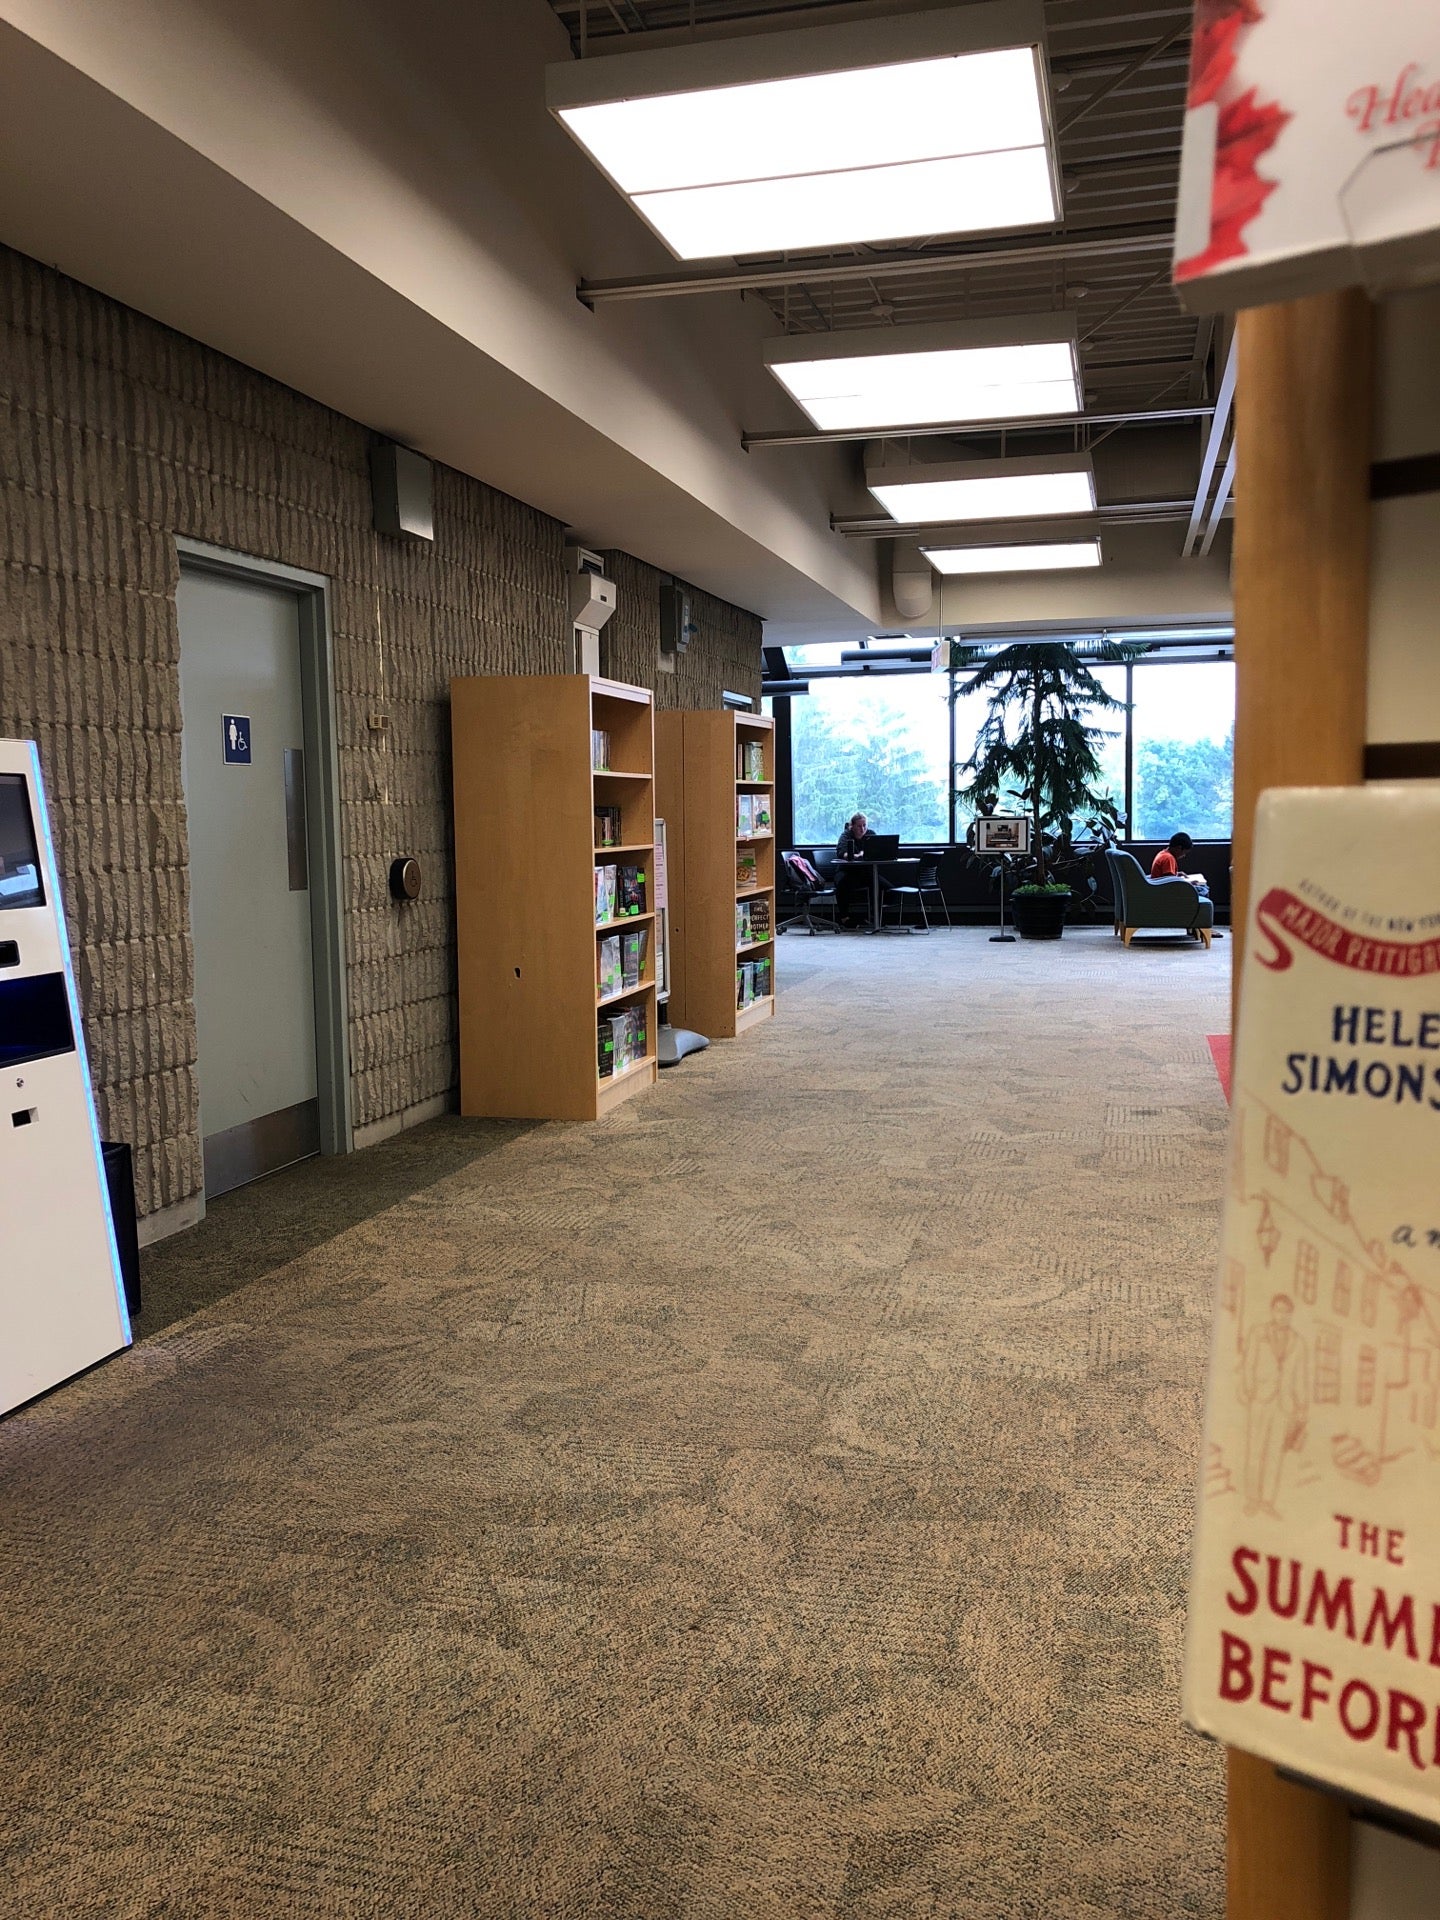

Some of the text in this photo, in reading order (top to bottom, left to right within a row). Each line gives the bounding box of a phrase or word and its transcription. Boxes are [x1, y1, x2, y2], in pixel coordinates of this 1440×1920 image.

[1283, 902, 1440, 975] MAJOR PETTIGR
[1332, 1004, 1440, 1049] HELE
[1334, 1513, 1404, 1567] THE
[1218, 1629, 1440, 1771] BEFOR
